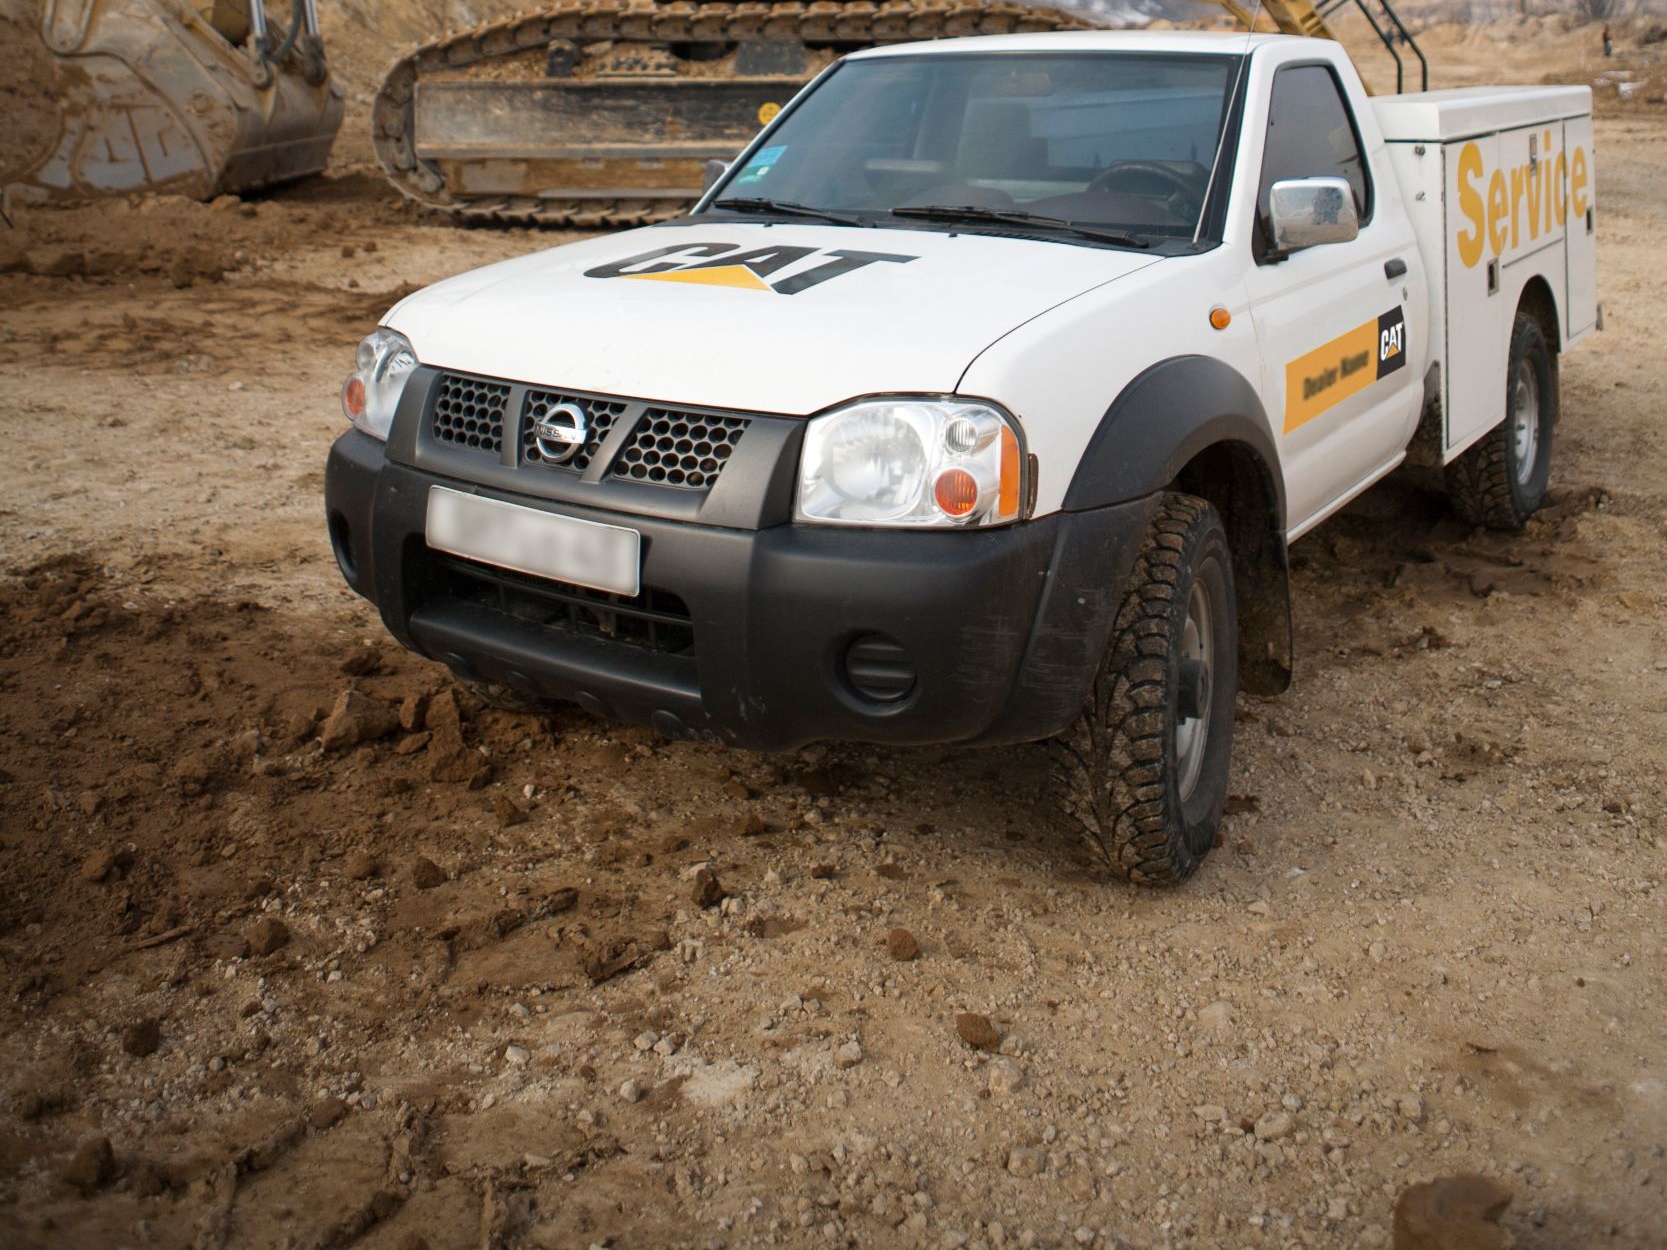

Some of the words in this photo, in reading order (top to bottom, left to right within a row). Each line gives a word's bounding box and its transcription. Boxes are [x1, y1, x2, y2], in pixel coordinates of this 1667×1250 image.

[1457, 129, 1588, 268] Service
[583, 242, 922, 296] CAT
[1380, 321, 1403, 361] CAT
[535, 423, 578, 441] NISSN
